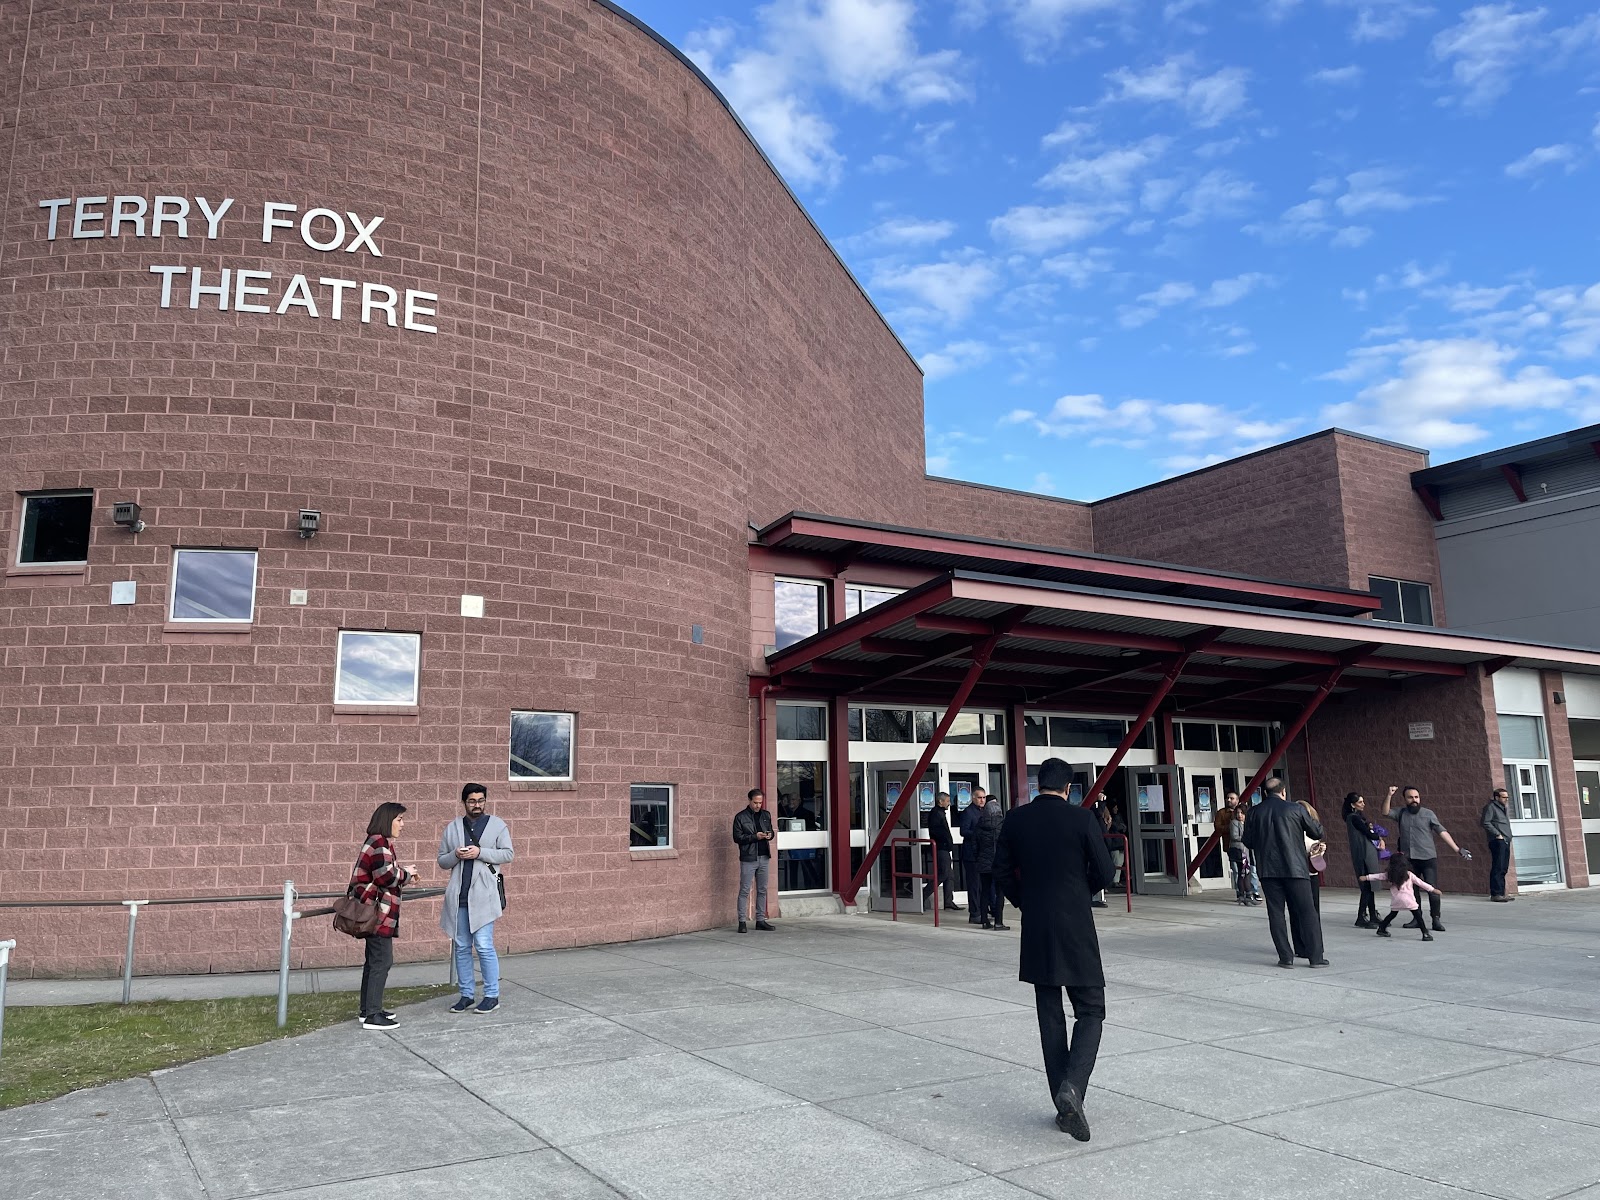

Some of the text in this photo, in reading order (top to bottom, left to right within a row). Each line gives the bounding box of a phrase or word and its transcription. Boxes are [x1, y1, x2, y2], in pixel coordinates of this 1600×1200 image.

[39, 196, 385, 257] TERRY FOX
[149, 265, 439, 335] THEATRE
